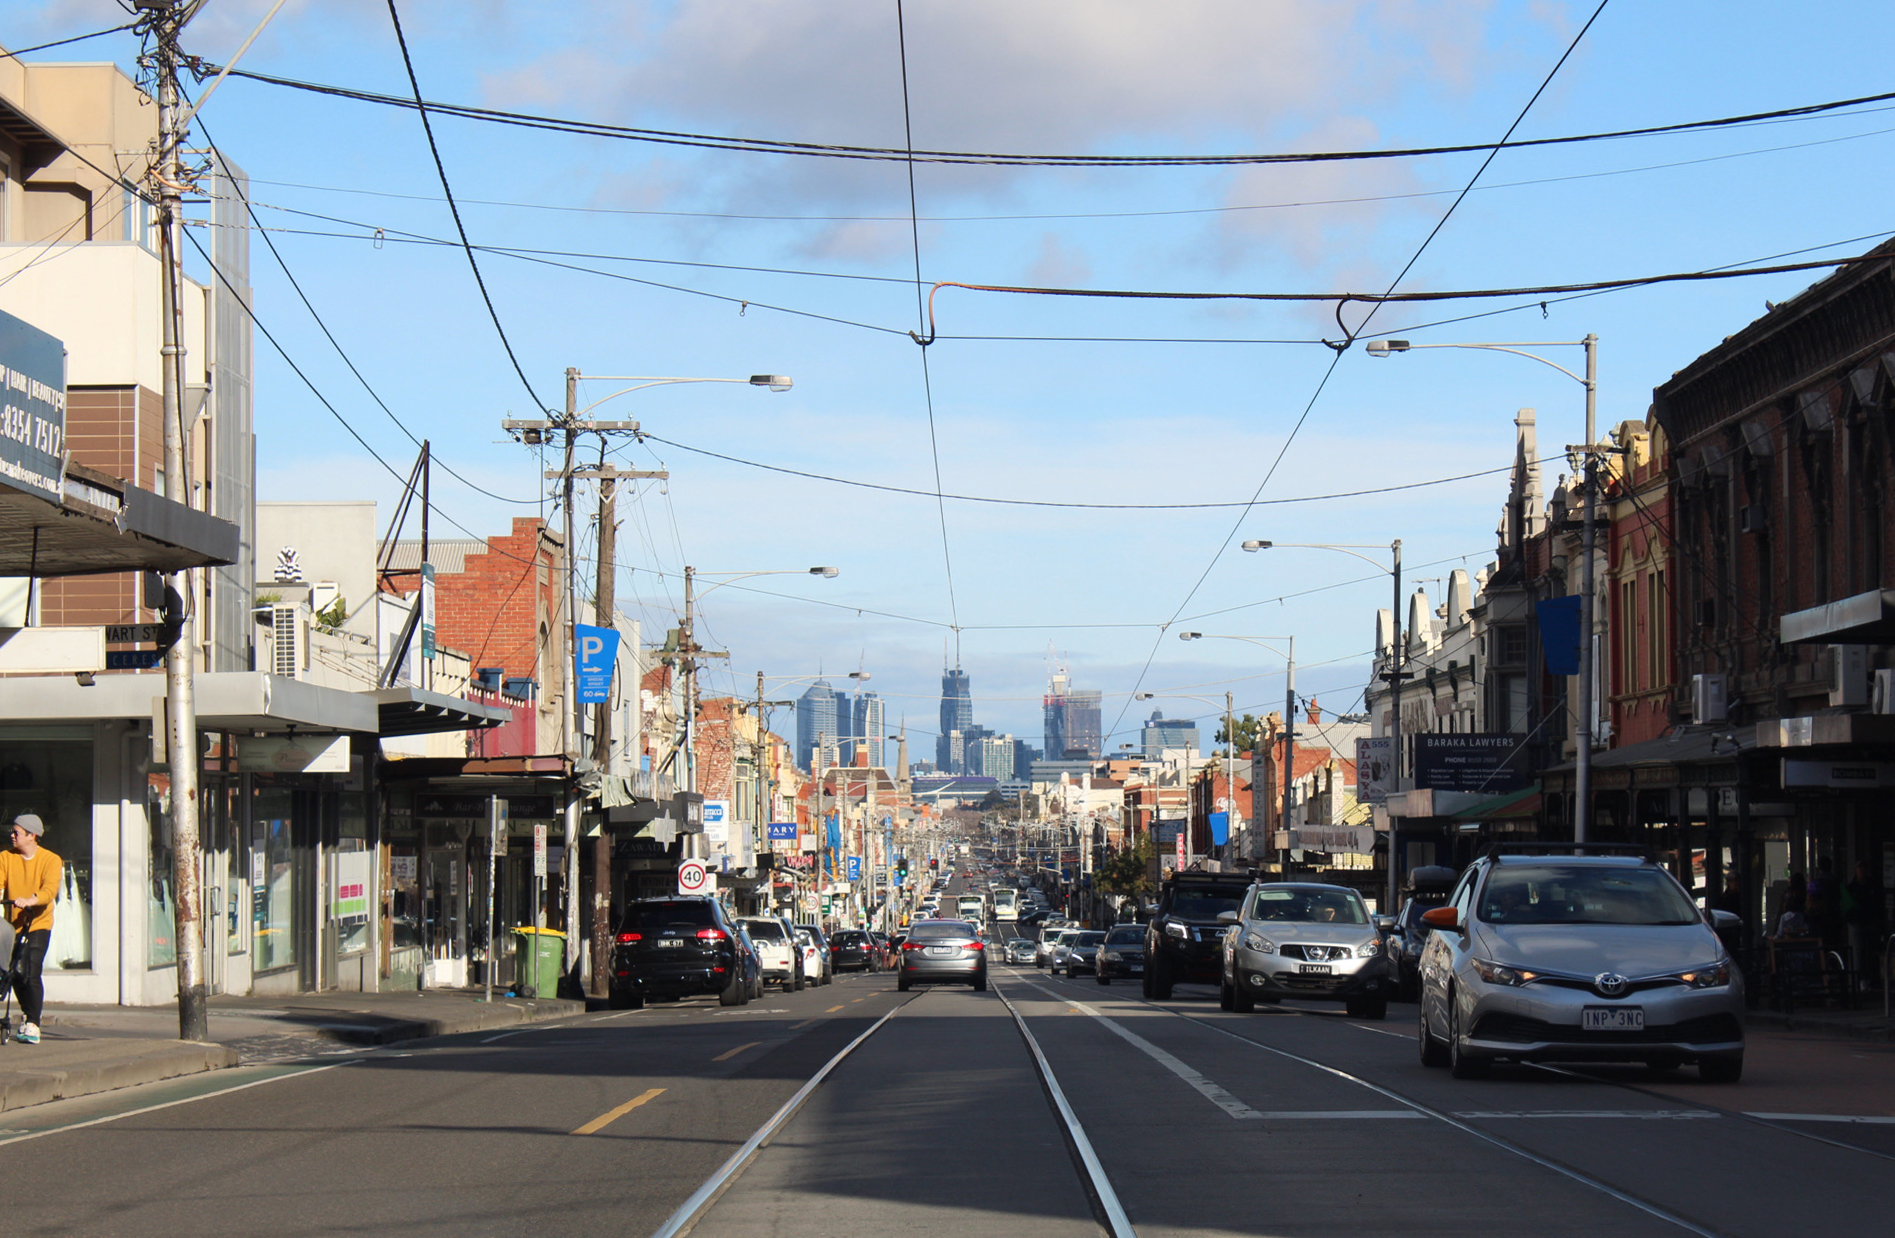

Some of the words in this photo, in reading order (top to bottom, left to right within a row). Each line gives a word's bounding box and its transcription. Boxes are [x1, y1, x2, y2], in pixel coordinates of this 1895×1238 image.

[11, 369, 27, 393] HAIR
[32, 379, 56, 406] BEAUTY
[36, 417, 60, 458] 7512
[582, 636, 604, 664] P
[583, 690, 594, 698] 60
[1427, 738, 1466, 747] BARAKA
[1469, 738, 1514, 747] LAWYERS
[1360, 741, 1371, 800] ALASYA
[618, 842, 662, 852] ZAWAD
[849, 859, 858, 869] P
[683, 871, 702, 883] 40
[1586, 1011, 1608, 1026] 1NP
[1618, 1011, 1643, 1026] 3NC
